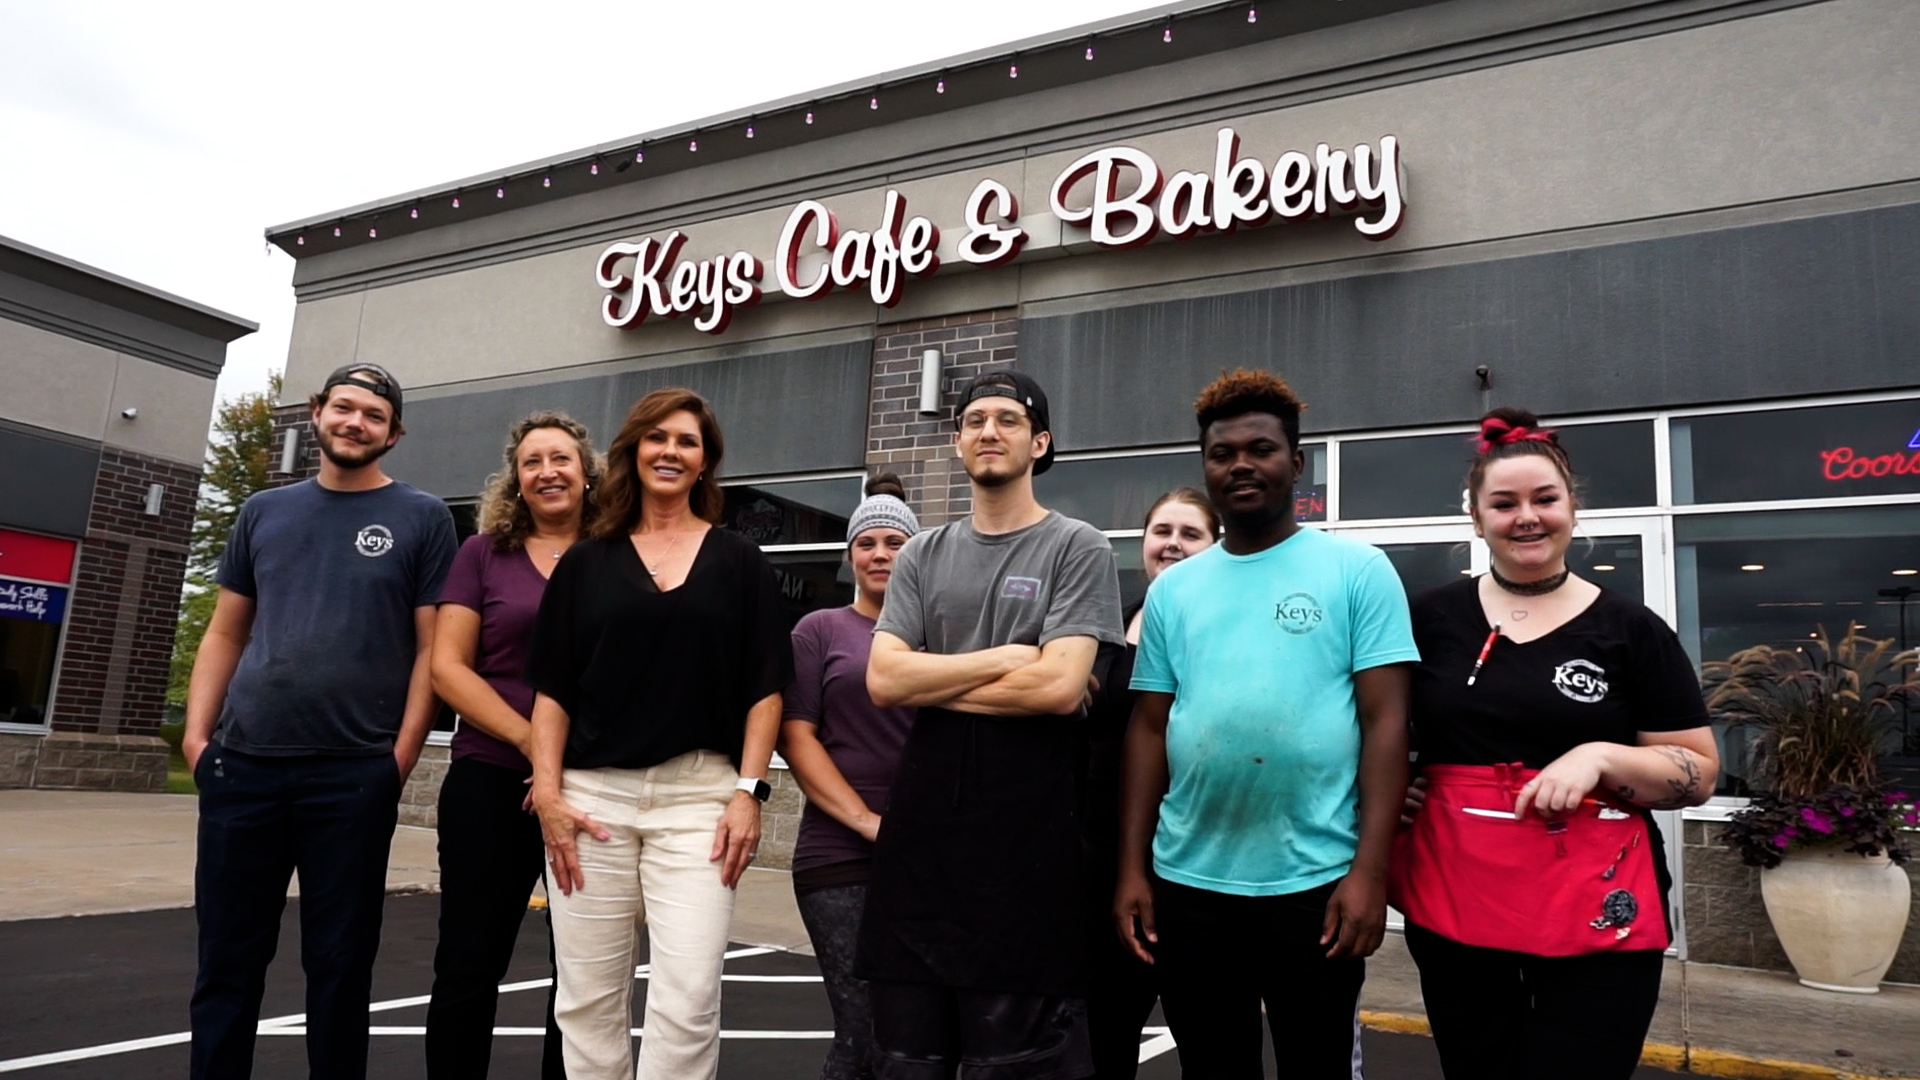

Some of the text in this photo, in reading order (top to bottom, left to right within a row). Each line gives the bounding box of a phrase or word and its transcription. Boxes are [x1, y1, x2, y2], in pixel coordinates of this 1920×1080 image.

[596, 127, 1404, 333] Keys Cafe & Bakery
[1294, 496, 1326, 516] EN
[355, 531, 395, 551] Keys
[1274, 603, 1322, 625] Keys
[1551, 666, 1609, 694] Keys
